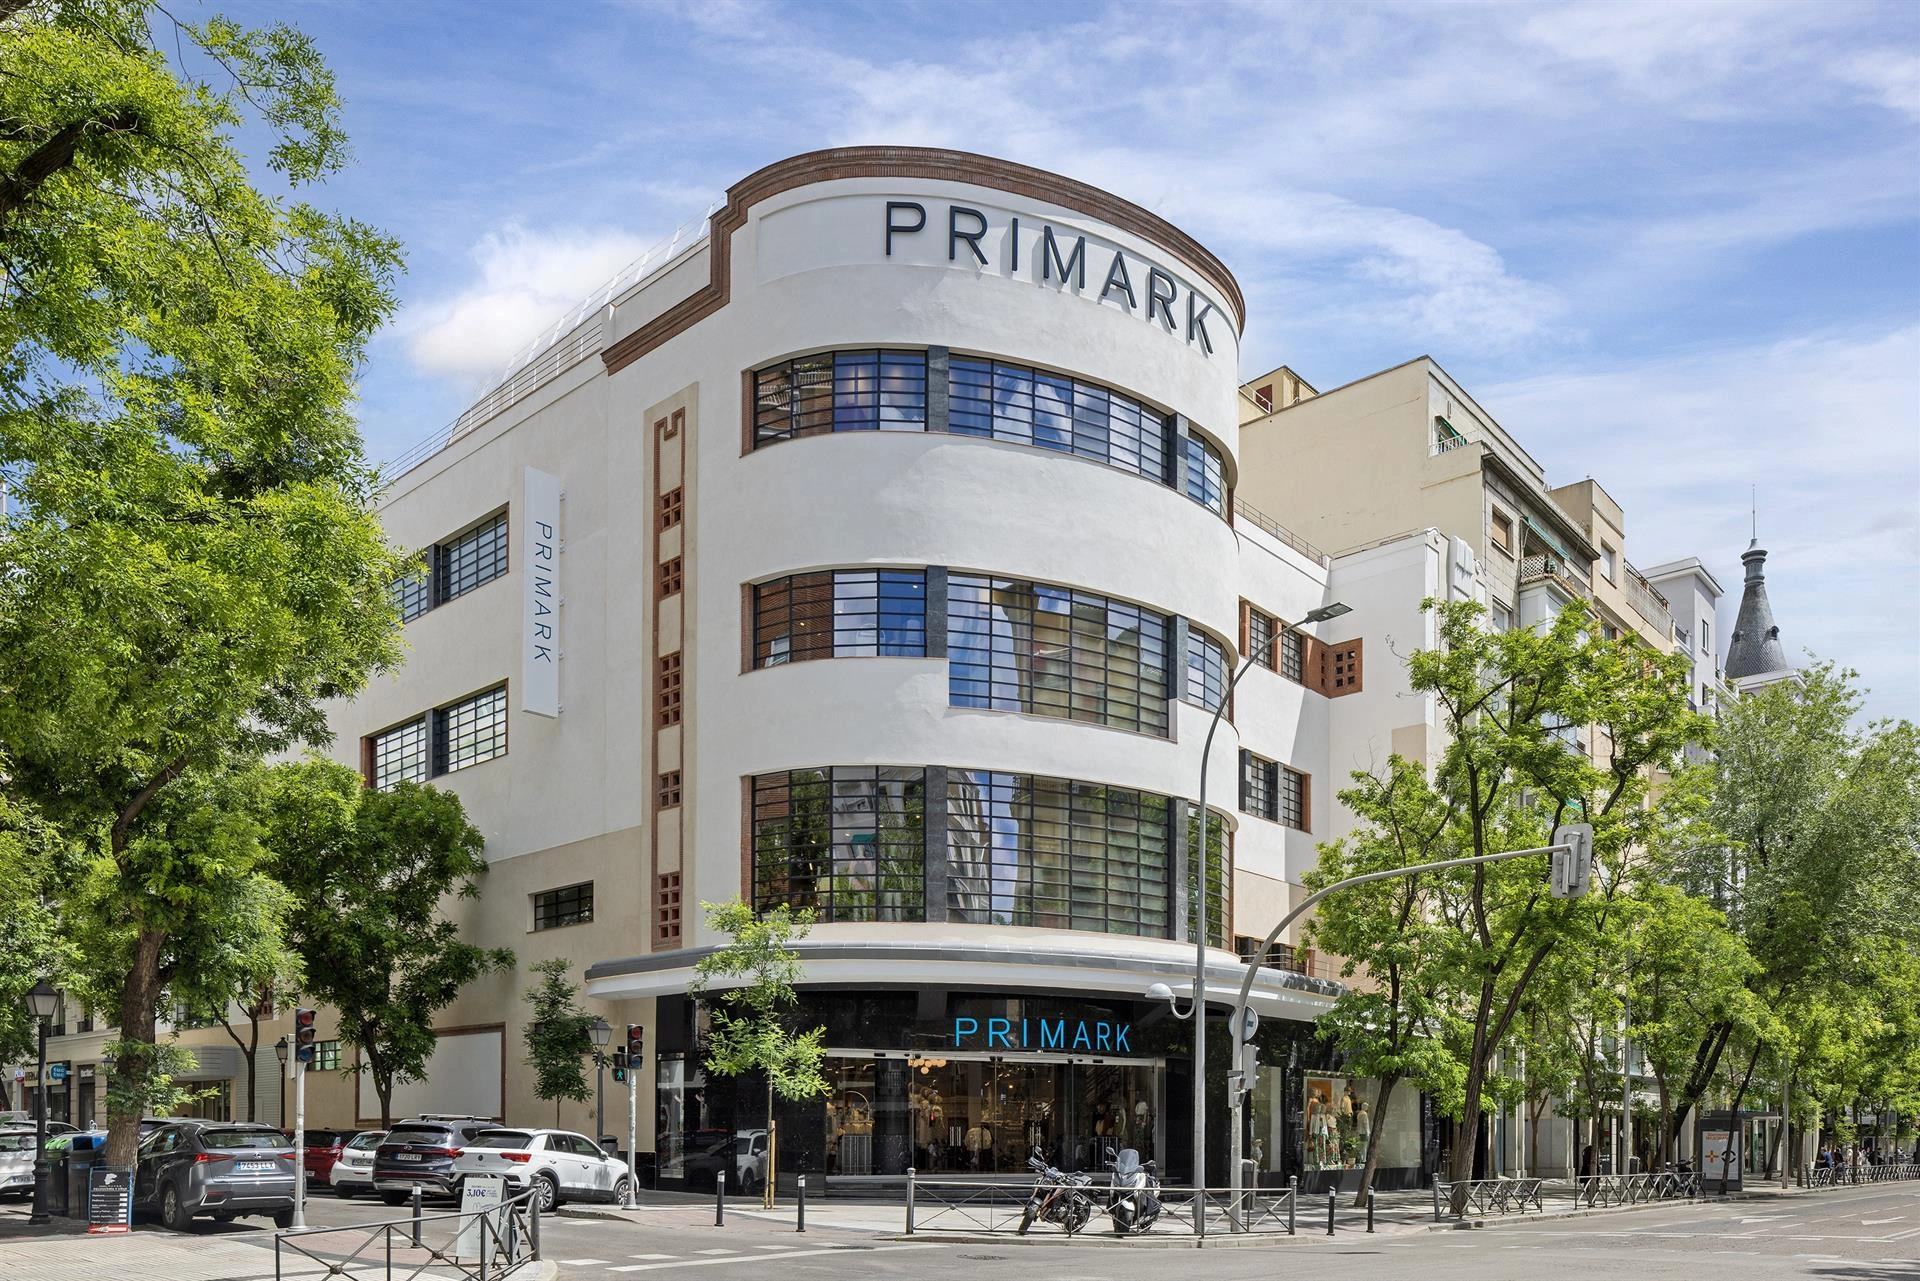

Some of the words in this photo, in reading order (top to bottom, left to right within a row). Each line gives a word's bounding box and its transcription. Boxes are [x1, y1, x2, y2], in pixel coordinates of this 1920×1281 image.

[886, 201, 1214, 354] PRIMARK
[534, 520, 553, 663] PRIMARK
[955, 1017, 1131, 1052] PRIMARK
